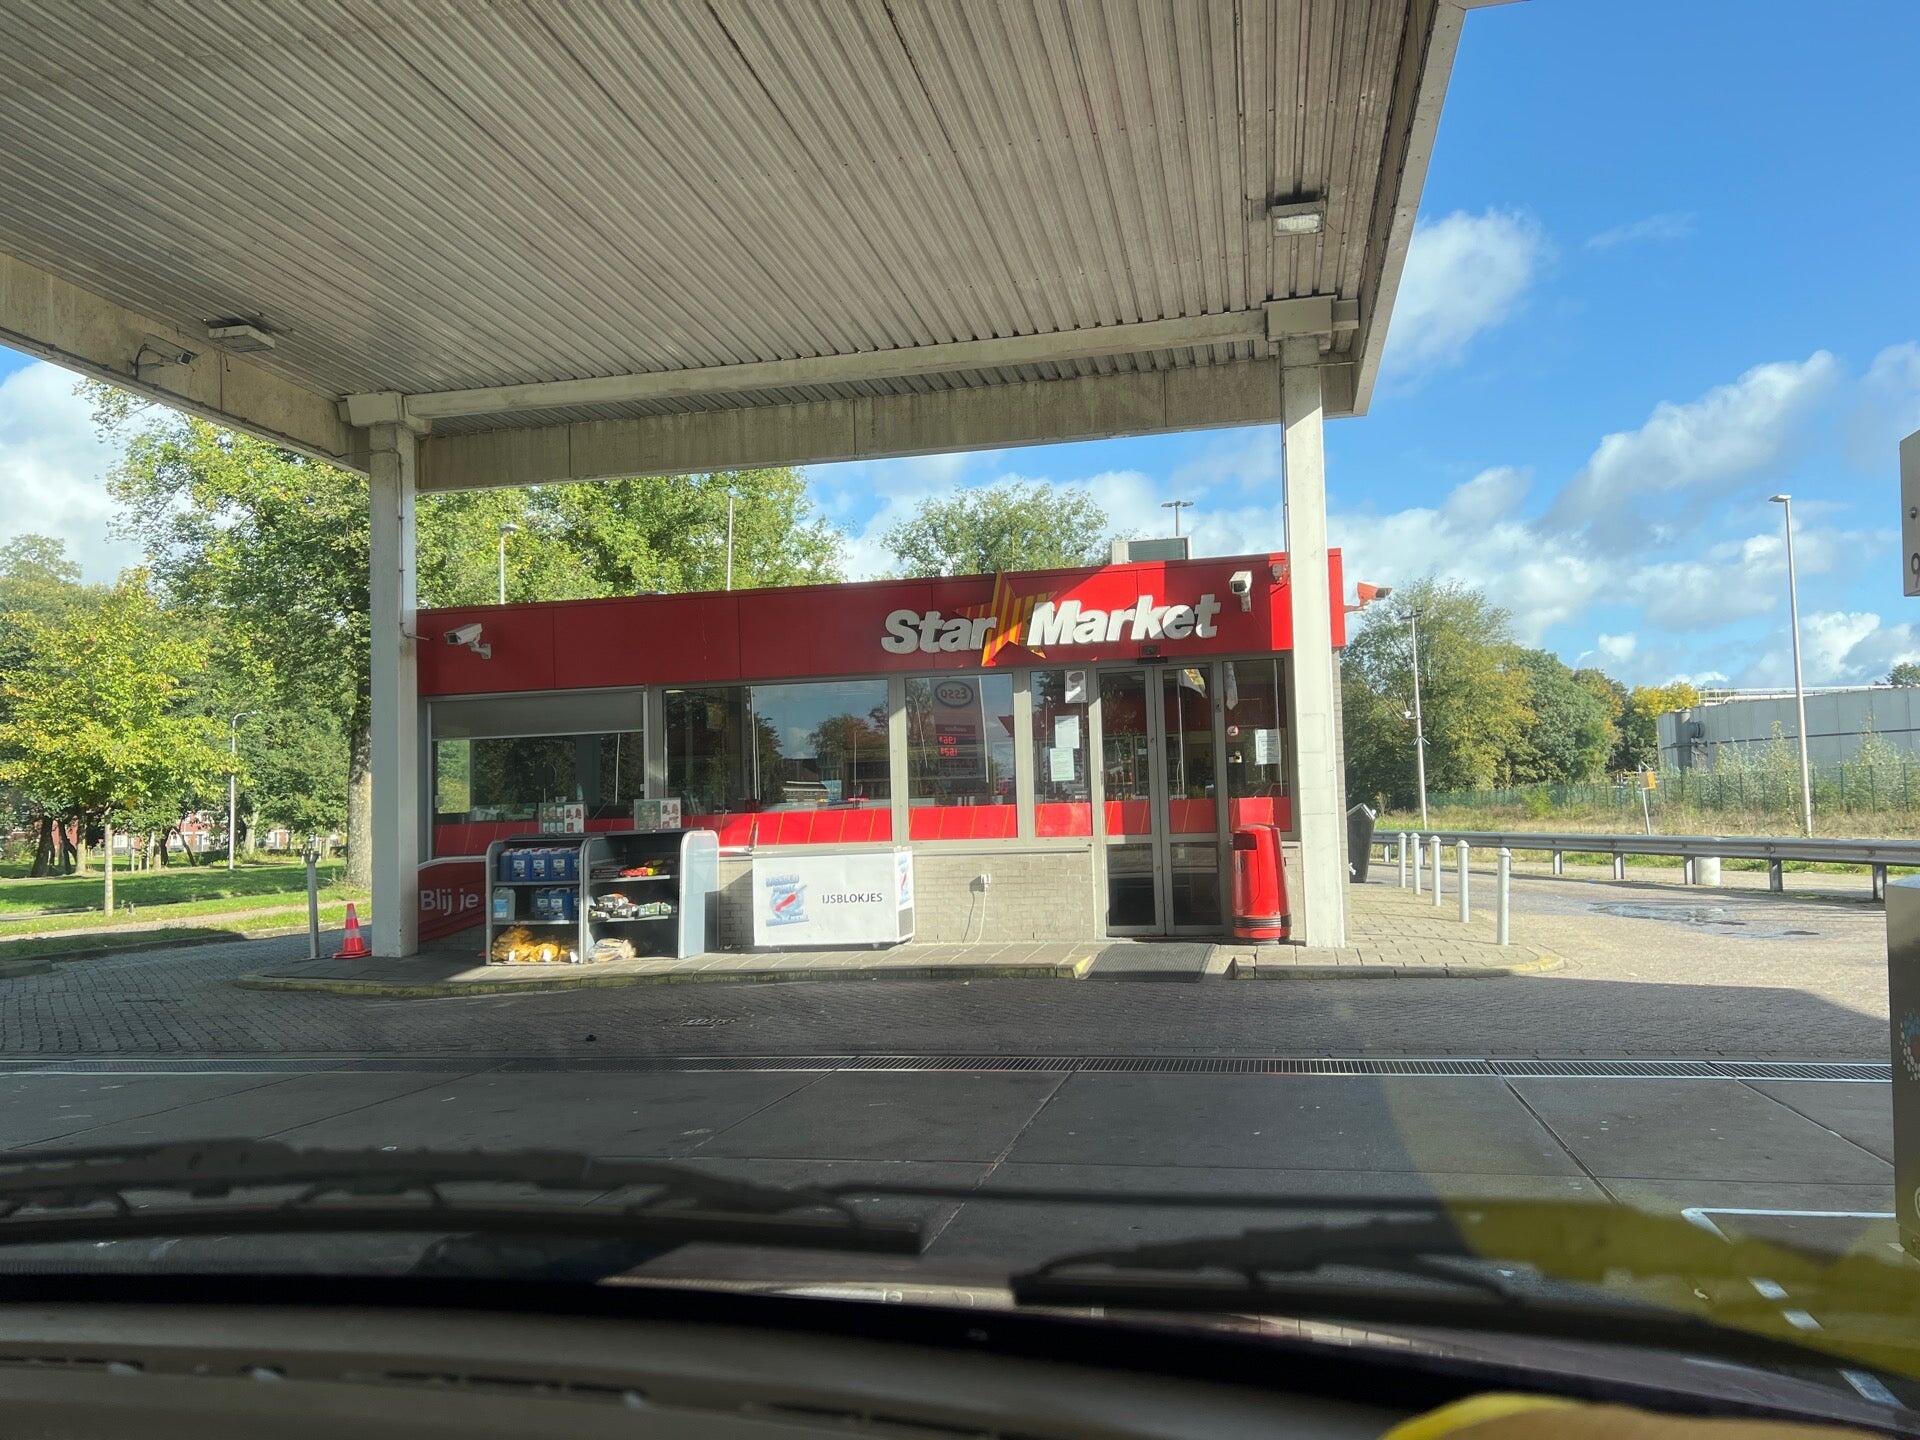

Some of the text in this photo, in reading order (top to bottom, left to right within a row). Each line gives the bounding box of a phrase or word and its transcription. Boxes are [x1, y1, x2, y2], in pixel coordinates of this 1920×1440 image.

[881, 594, 1221, 654] Star Market
[420, 888, 452, 916] Blij
[460, 888, 479, 914] je
[822, 893, 883, 904] IJSBLOKJES
